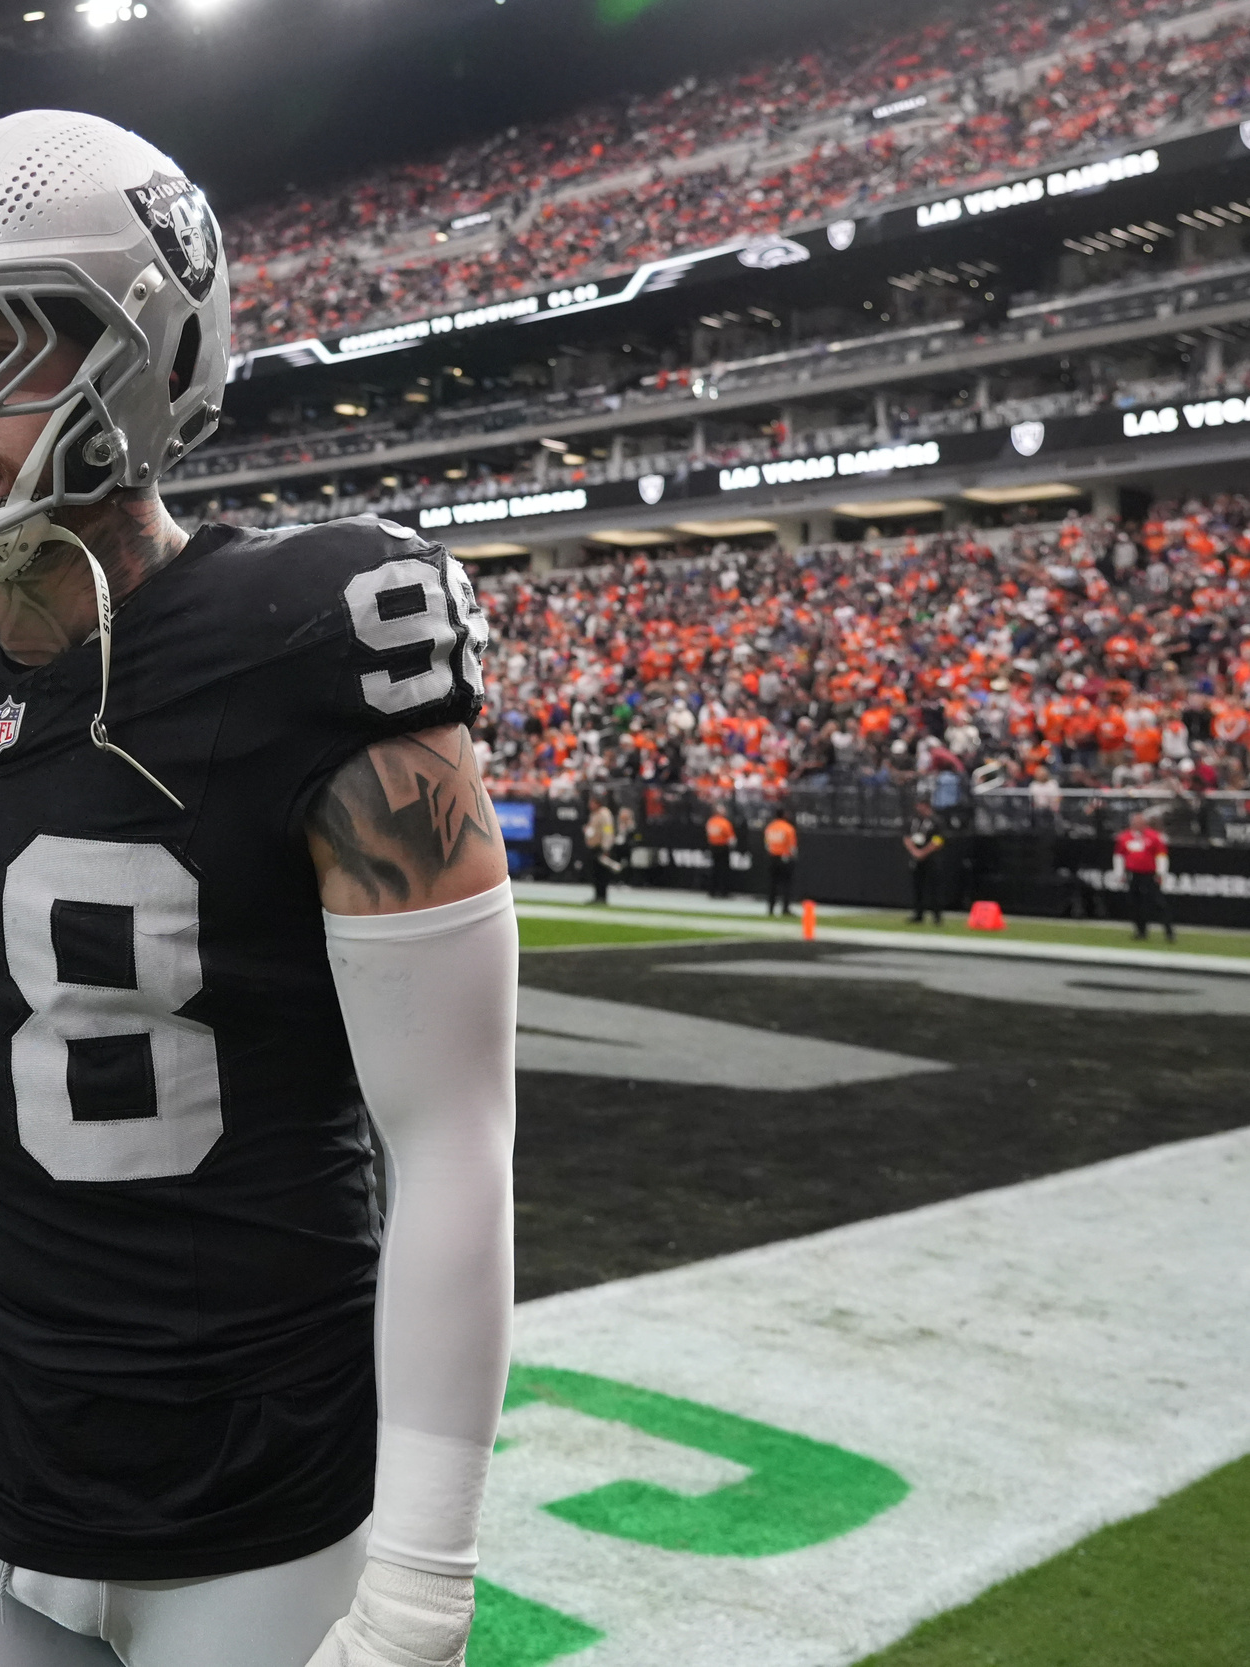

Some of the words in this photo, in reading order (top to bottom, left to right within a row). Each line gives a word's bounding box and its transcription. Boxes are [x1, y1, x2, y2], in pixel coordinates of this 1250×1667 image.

[135, 179, 194, 205] RAIDERS
[917, 199, 962, 227] LAS
[964, 178, 1044, 215] VEGAS
[1047, 150, 1159, 196] RAIDERS
[1124, 408, 1179, 437] LAS
[720, 466, 760, 490] LAS
[762, 456, 835, 484] VEGAS
[837, 441, 939, 475] RAIDERS
[420, 507, 452, 528] LAS
[452, 499, 509, 523] VEGAS
[509, 489, 586, 517] RAIDERS
